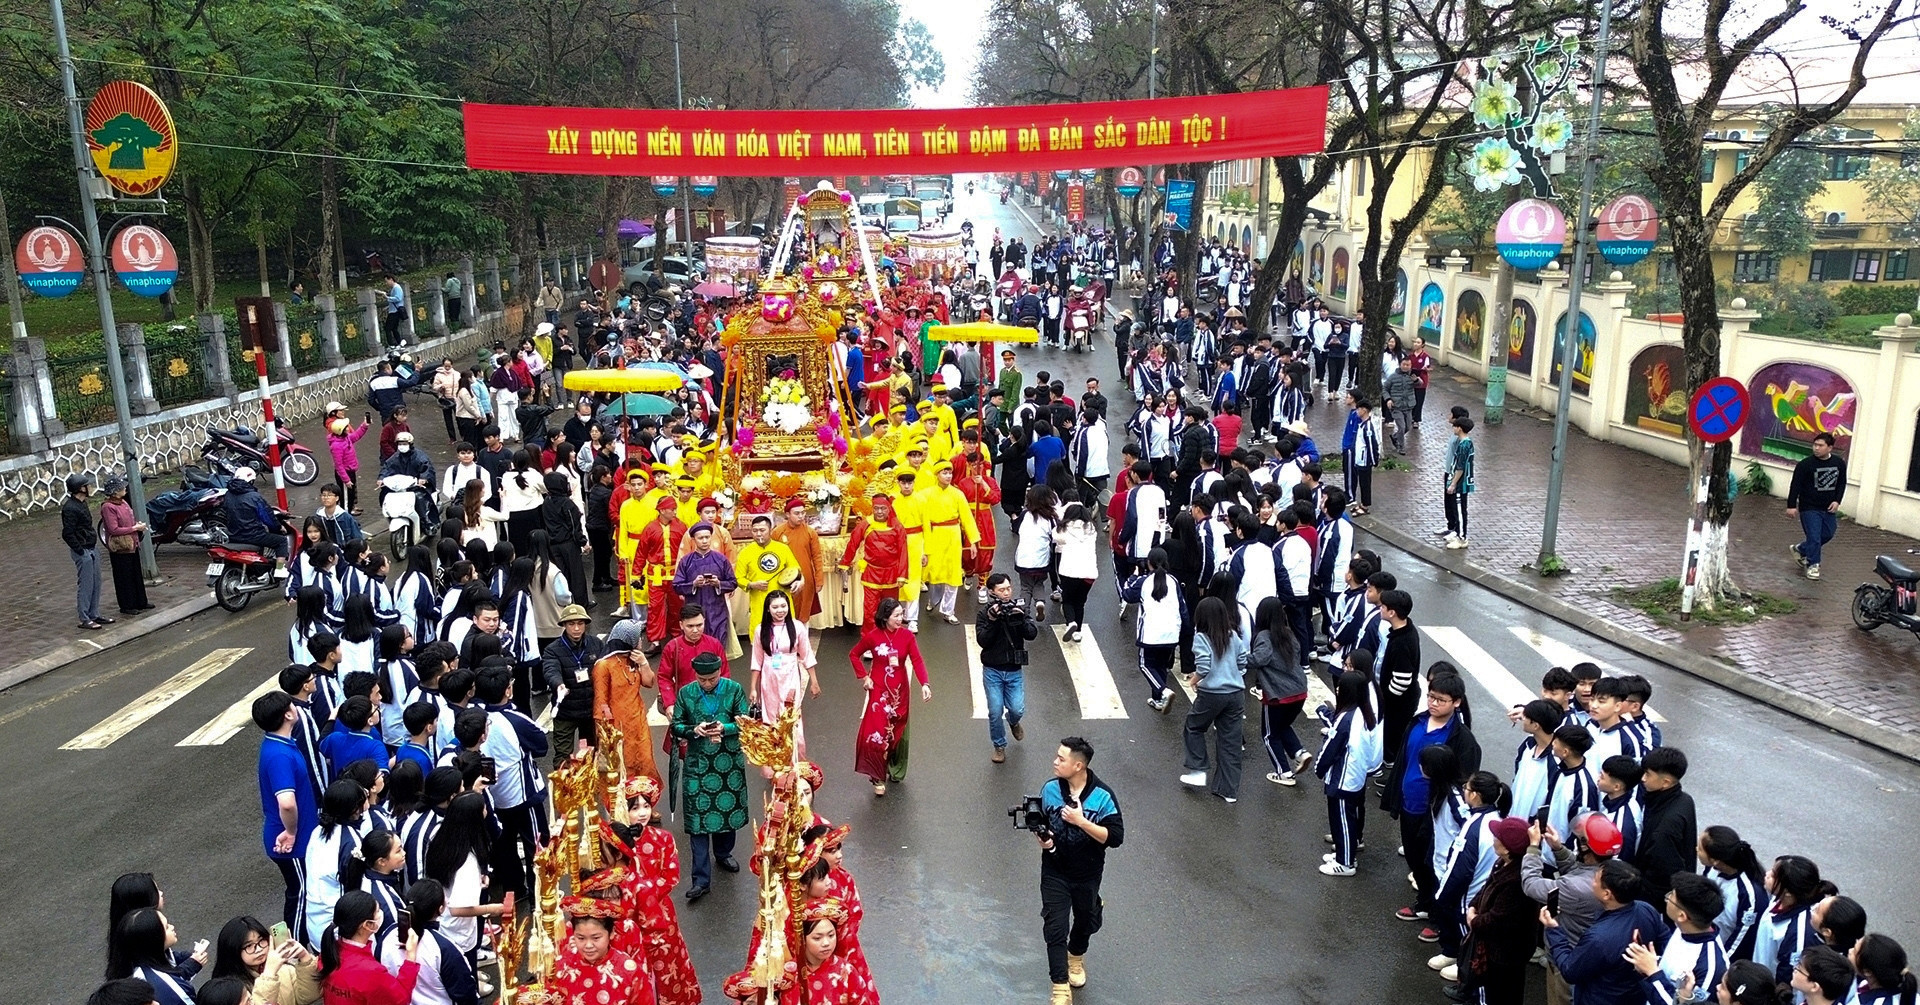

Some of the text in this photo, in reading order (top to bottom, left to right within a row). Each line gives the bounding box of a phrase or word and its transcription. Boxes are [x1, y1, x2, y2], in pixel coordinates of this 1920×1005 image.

[547, 113, 1226, 161] XÂY DỰNG NỀN VĂN HÓA VIỆT NAM, TIÊN TIẾN ĐẬM ĐÀ BẢN SẮC DÂN TỘC !
[1503, 248, 1554, 259] vinaphone
[1603, 246, 1648, 255] vinaphone
[28, 278, 77, 287] vinaphone
[125, 277, 171, 287] vinaphone
